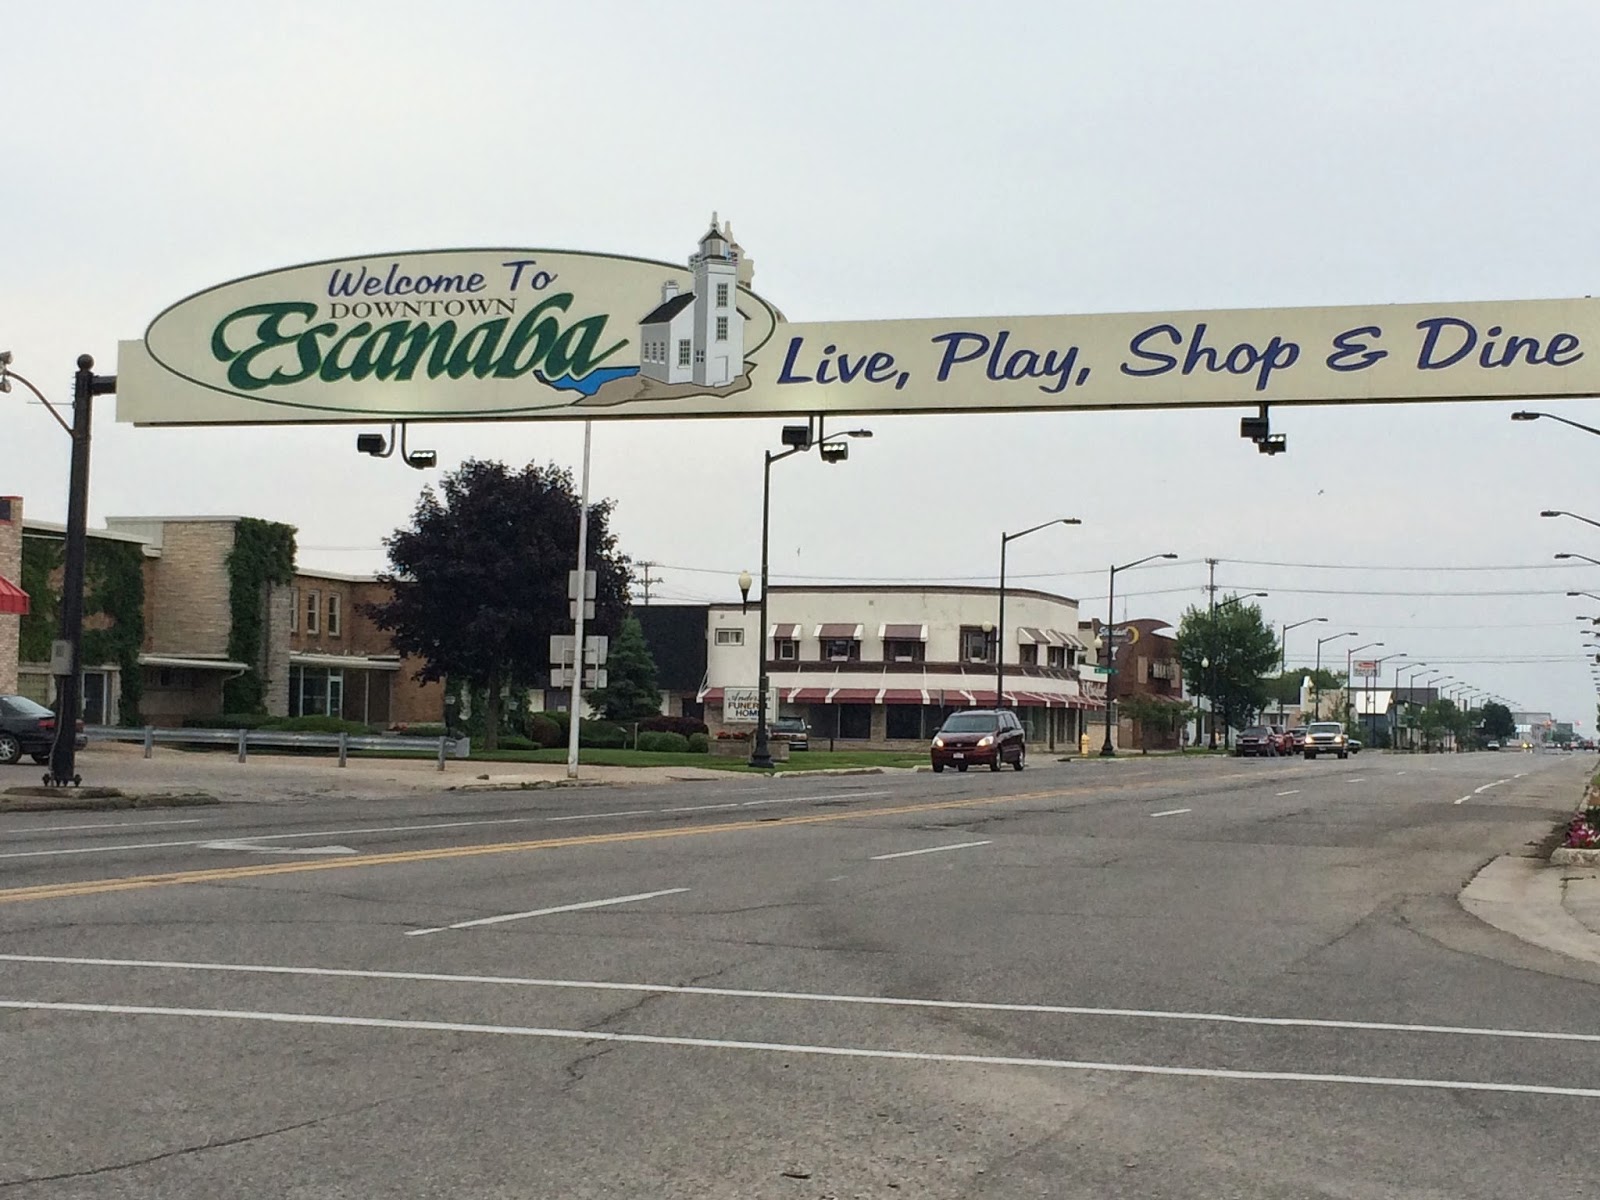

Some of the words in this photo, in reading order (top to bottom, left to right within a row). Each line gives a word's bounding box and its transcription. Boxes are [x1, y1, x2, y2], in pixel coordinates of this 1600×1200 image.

[327, 264, 487, 297] Welcome
[502, 260, 557, 291] To
[329, 297, 517, 320] DOWNTOWN
[210, 293, 630, 391] Escanaba
[777, 336, 910, 388] Live,
[931, 331, 1092, 393] Play,
[1120, 324, 1301, 389] Shop
[1326, 327, 1388, 371] &
[1416, 317, 1584, 370] Dine
[728, 702, 771, 710] FUNERL
[735, 709, 761, 717] HOM
